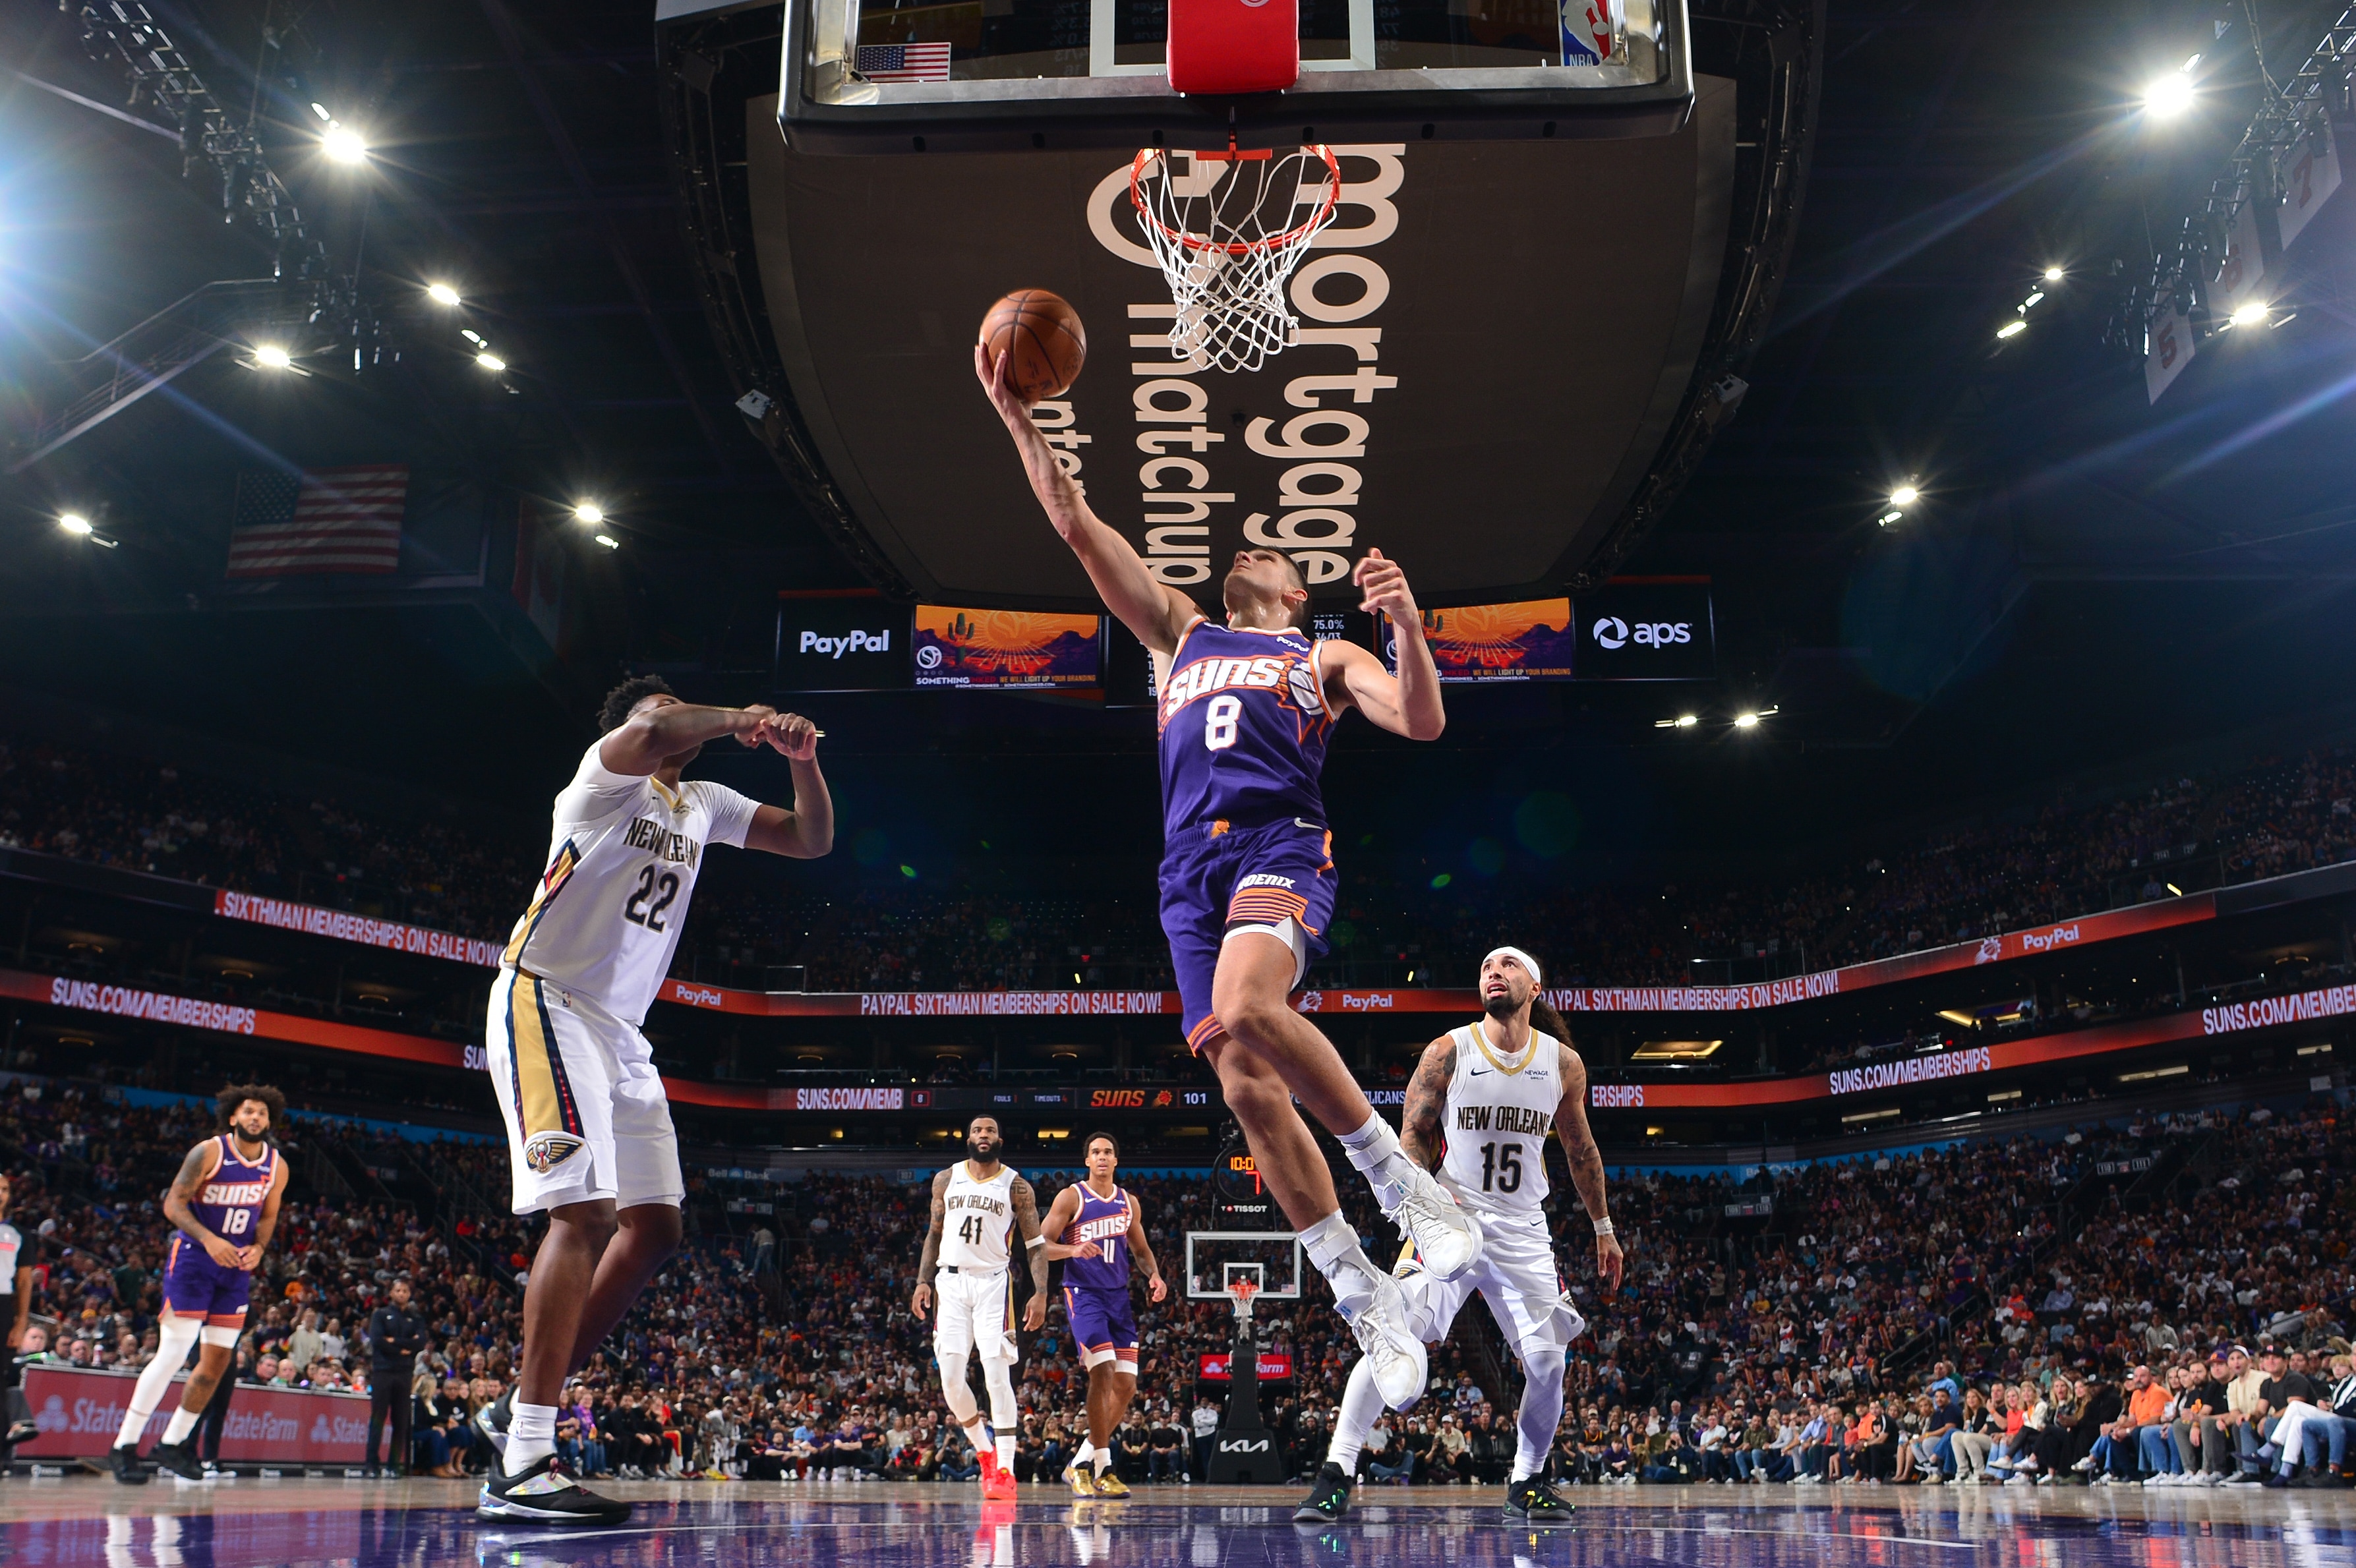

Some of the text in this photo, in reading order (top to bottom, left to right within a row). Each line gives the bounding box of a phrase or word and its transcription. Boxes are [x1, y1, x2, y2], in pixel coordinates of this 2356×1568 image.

[1569, 53, 1593, 66] NBA
[2158, 322, 2177, 370] 5
[1243, 144, 1406, 584] mortgage
[1030, 400, 1092, 496] nte
[1128, 304, 1235, 585] matchup
[1313, 620, 1345, 629] 75.0%
[1633, 623, 1692, 649] aps
[800, 629, 889, 659] PayPal
[1276, 636, 1310, 653] PayPal
[1205, 695, 1243, 751] 8
[623, 817, 667, 856] NEW
[624, 863, 680, 934] 22
[224, 891, 504, 968] SIXTHMAN MEMBERSHIPS ON SALE NOW
[2022, 924, 2080, 950] PayPal
[676, 984, 722, 1006] PayPal
[1343, 994, 1393, 1012] PayPal
[1593, 989, 1659, 1011] SIXTHMAN
[1661, 987, 1750, 1010] MEMBERSHIPS
[1752, 985, 1771, 1007] ON
[1772, 978, 1804, 1005] SALE
[1804, 970, 1839, 1000] NOW!
[51, 977, 256, 1035] SUNS.COM/MEMBERSHIPS
[861, 992, 1162, 1016] PAYPAL SIXTHMAN MEMBERSHIPS ON SALE NOW!
[2202, 984, 2356, 1035] SUNS.COM/MEMBE
[1829, 1046, 1991, 1095] SUNS.COM/MEMBERSHIPS
[796, 1088, 903, 1110] SUNS.COM/MEMB
[1090, 1089, 1146, 1107] SUNS
[1184, 1092, 1206, 1105] 101
[1363, 1091, 1406, 1105] LICANS
[1591, 1085, 1644, 1107] ERSHIPS
[1457, 1105, 1492, 1131] NEW
[708, 1168, 770, 1180] Bell Bank
[1230, 1157, 1254, 1171] 10:0
[1481, 1142, 1523, 1194] 15
[1245, 1171, 1260, 1195] 7
[948, 1194, 1005, 1217] NEW ORLEANS
[221, 1207, 251, 1234] 18
[959, 1215, 983, 1244] 41
[1104, 1238, 1115, 1263] 11
[1256, 1363, 1285, 1374] arm
[1220, 1439, 1269, 1453] KIA
